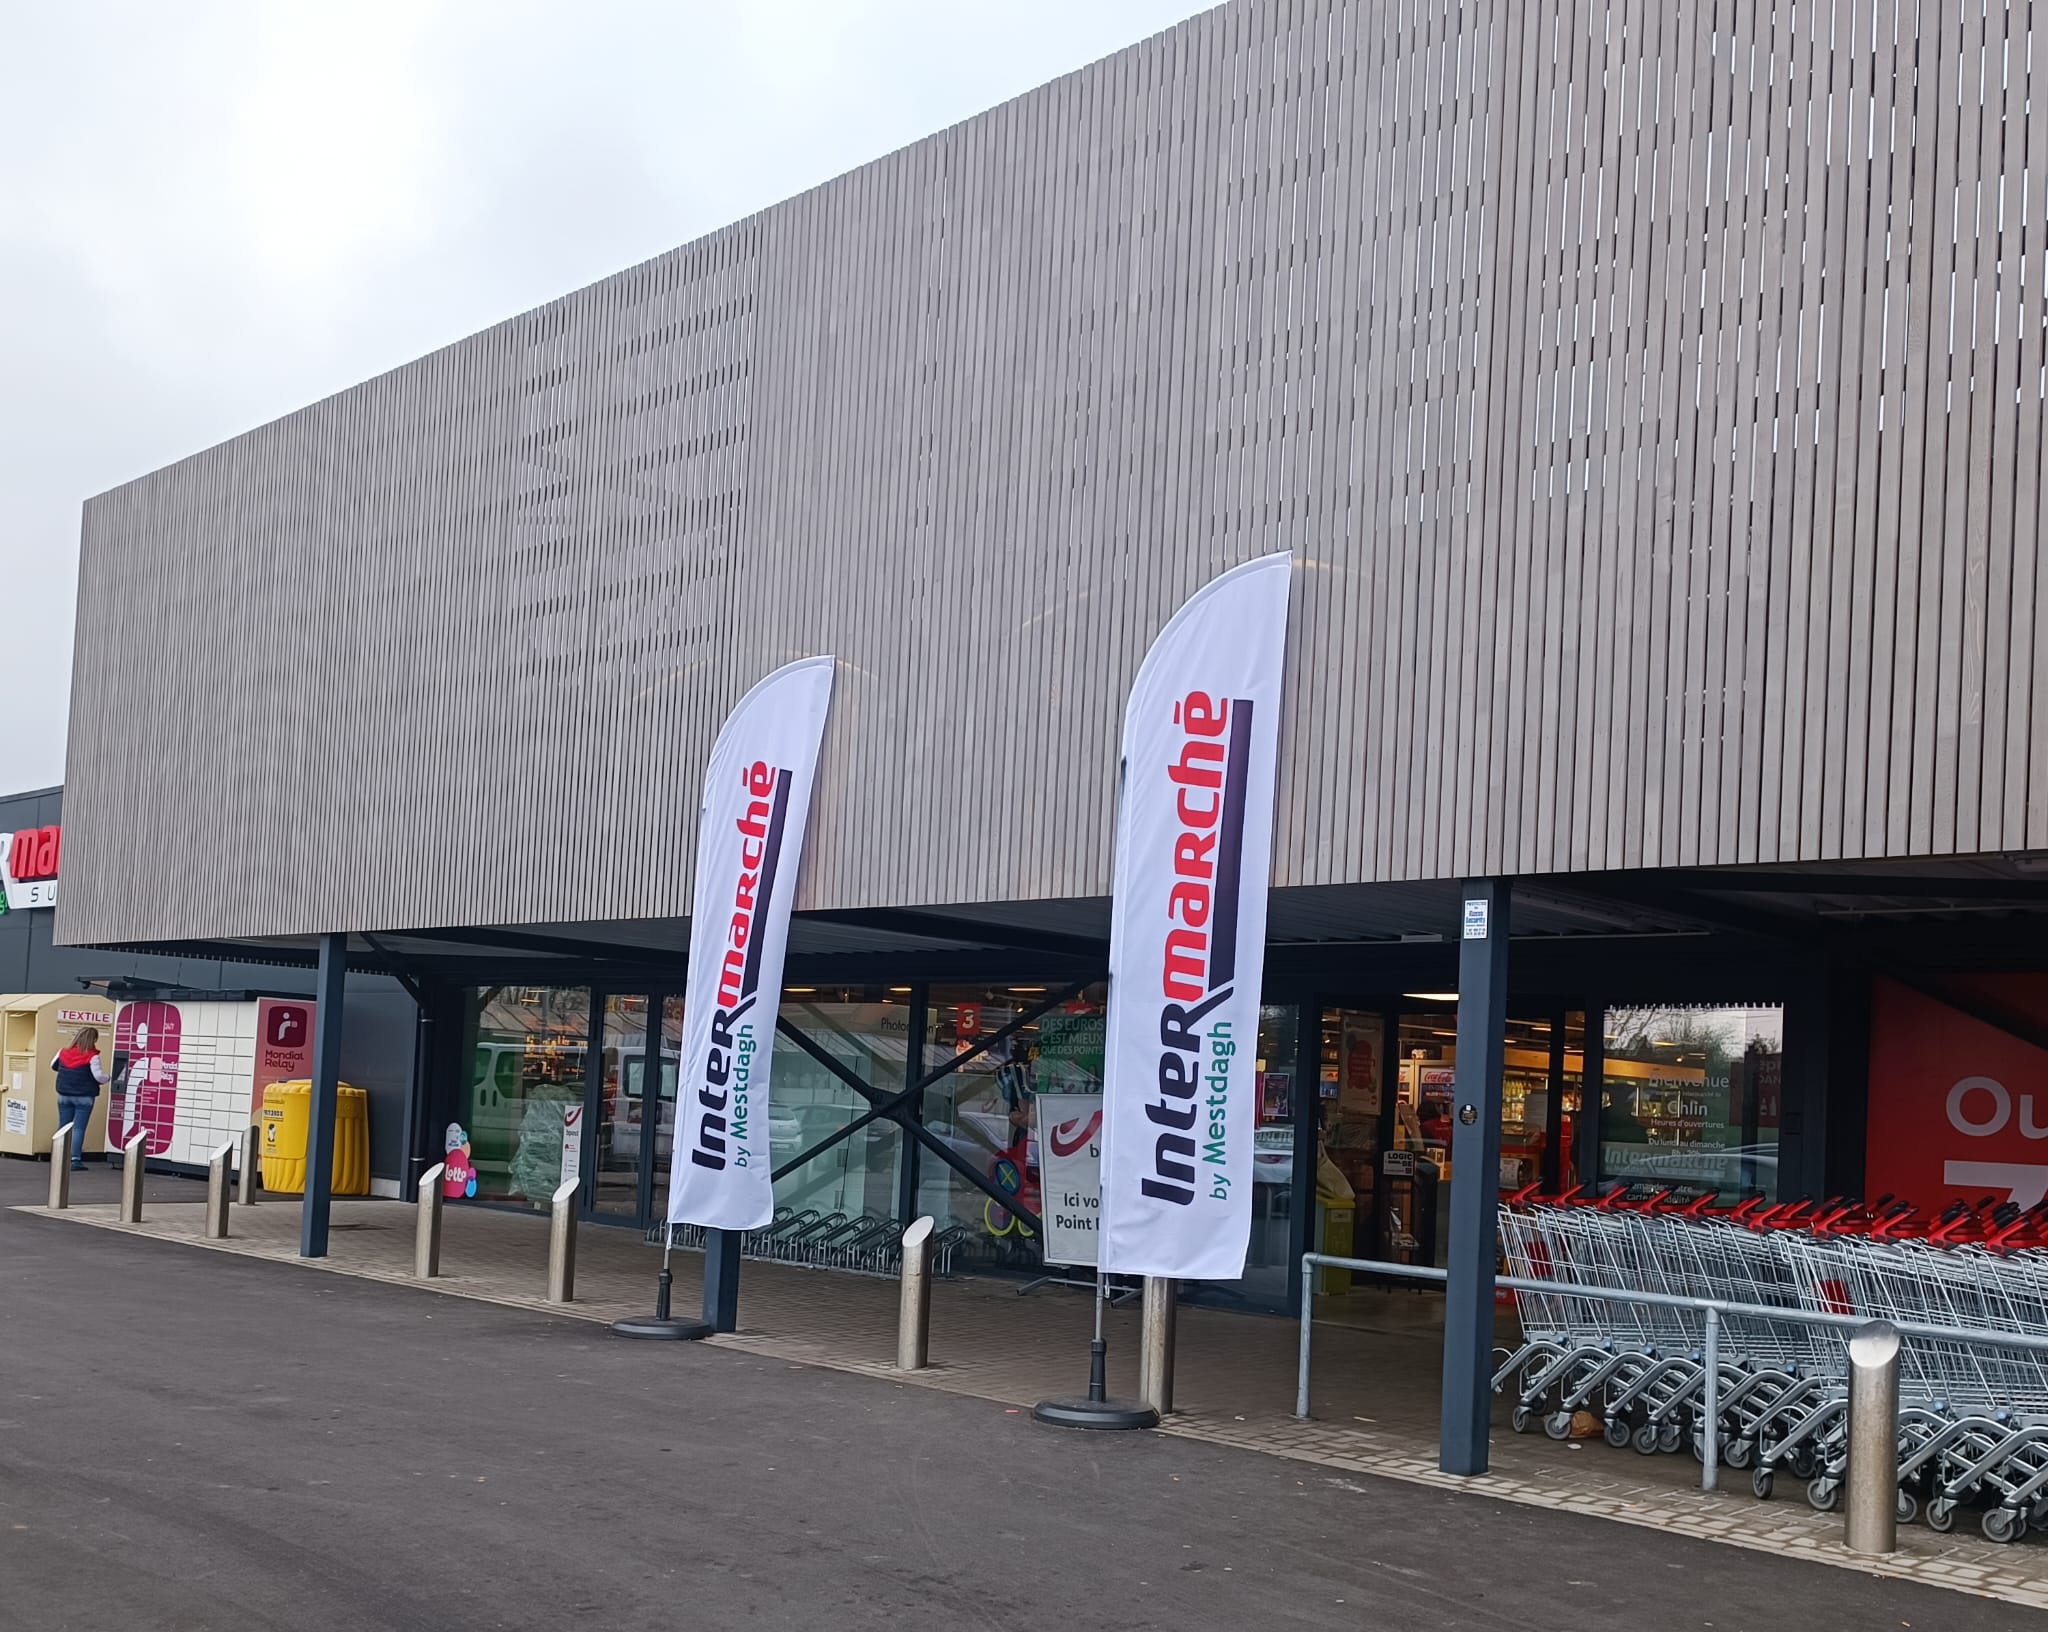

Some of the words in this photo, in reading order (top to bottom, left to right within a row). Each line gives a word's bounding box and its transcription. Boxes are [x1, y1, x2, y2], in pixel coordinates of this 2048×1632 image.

[61, 1009, 110, 1023] TEXTILE
[962, 1009, 975, 1029] 3
[1065, 1018, 1104, 1031] EUROS
[1069, 1032, 1104, 1044] MIEUX
[264, 1049, 304, 1060] Mondial
[264, 1058, 295, 1072] Relay
[729, 1024, 757, 1140] Mestdagh
[1202, 1022, 1237, 1166] Mestdagh
[1650, 1118, 1676, 1127] Heures
[1677, 1119, 1725, 1129] d'ouvertures
[1648, 1137, 1659, 1146] Du
[1689, 1140, 1726, 1149] dimanche
[734, 1146, 752, 1168] by
[1388, 1151, 1413, 1160] LOGIC
[1209, 1174, 1232, 1201] by
[1064, 1192, 1080, 1208] Ici
[1055, 1214, 1092, 1231] Point
